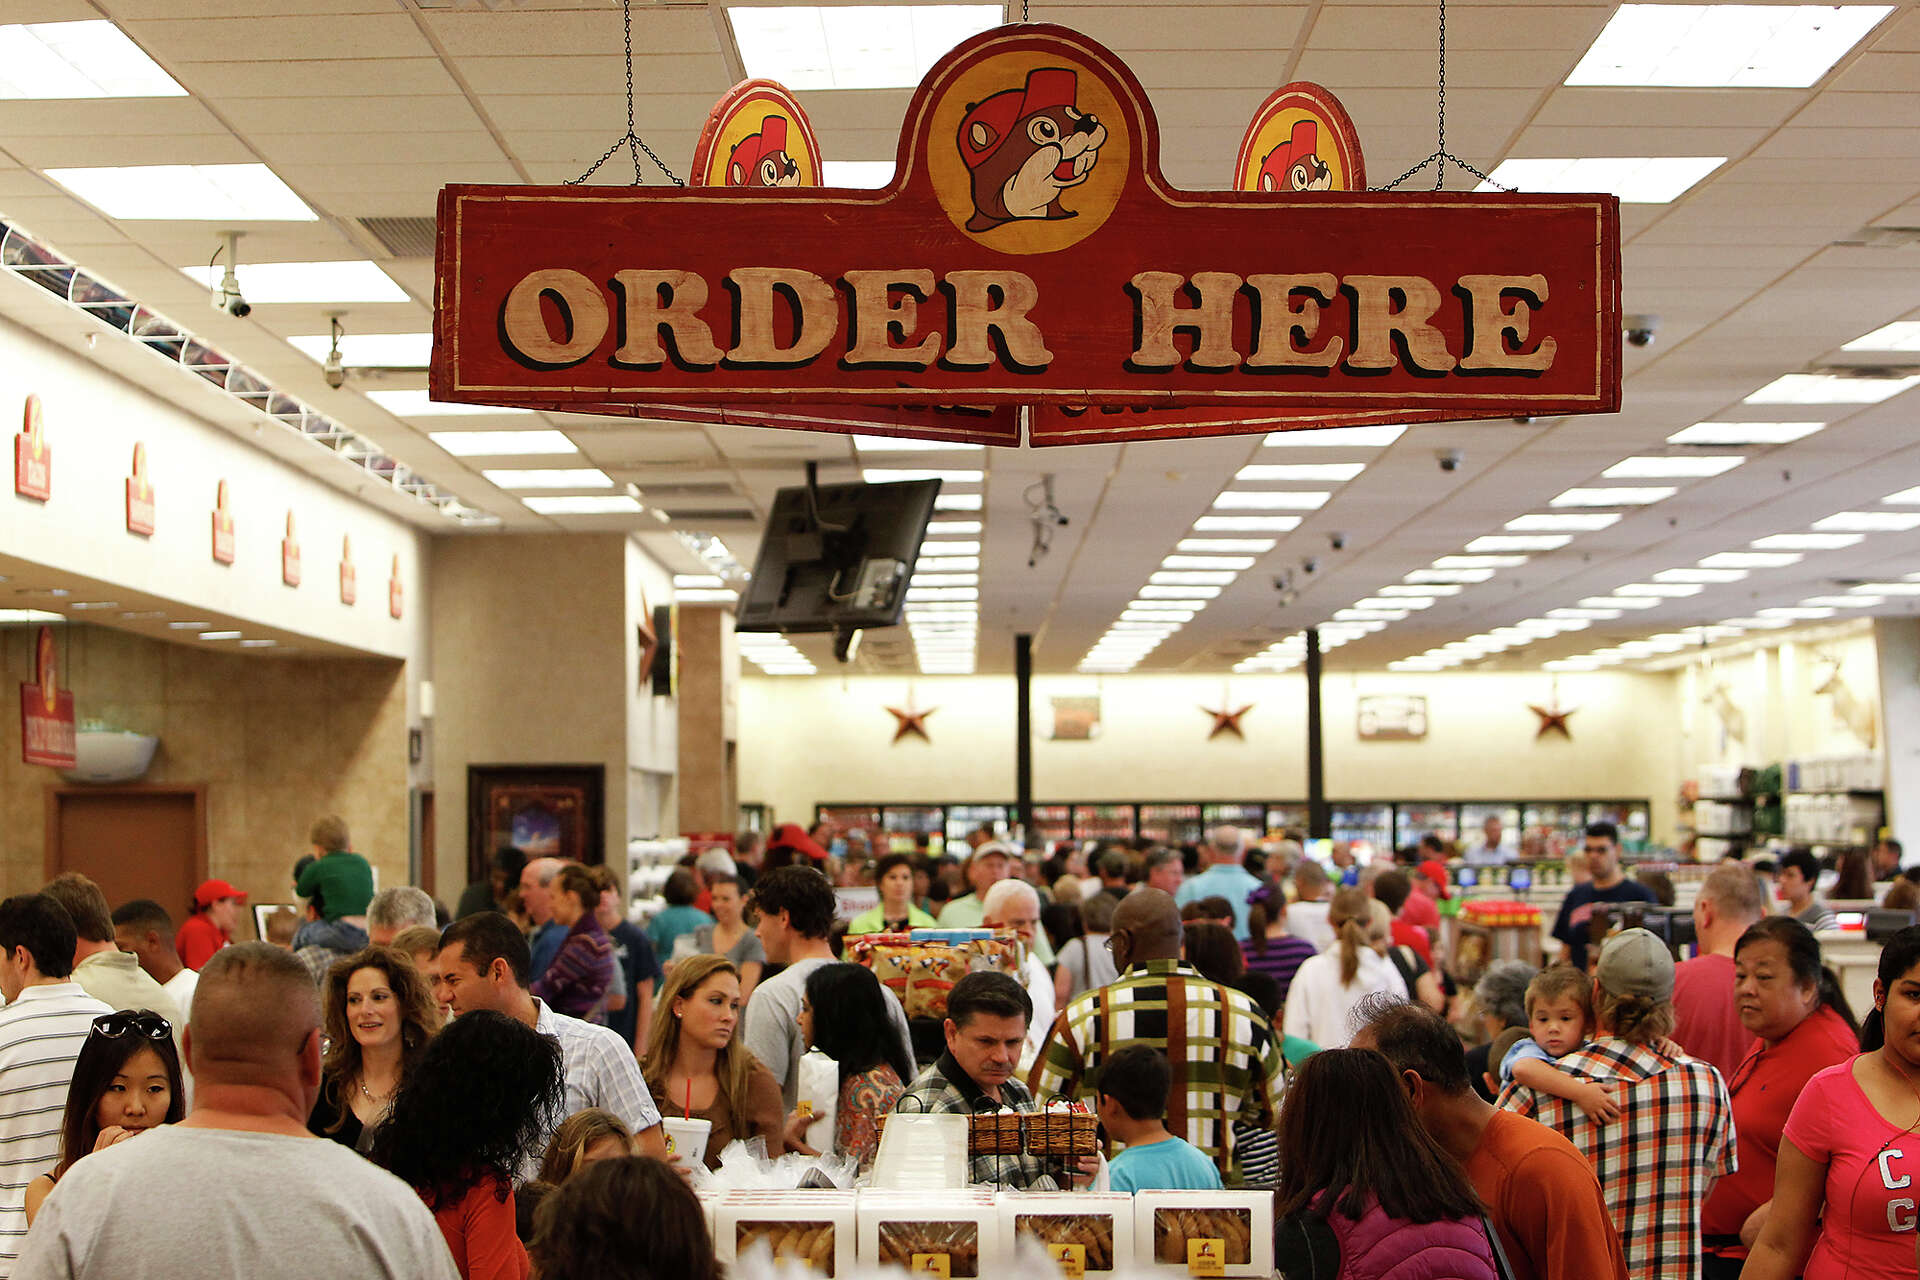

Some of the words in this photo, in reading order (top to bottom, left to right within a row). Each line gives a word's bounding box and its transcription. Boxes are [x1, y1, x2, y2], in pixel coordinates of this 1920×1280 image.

[500, 267, 1054, 372] ORDER
[1126, 271, 1557, 375] HERE
[1878, 1149, 1911, 1189] C
